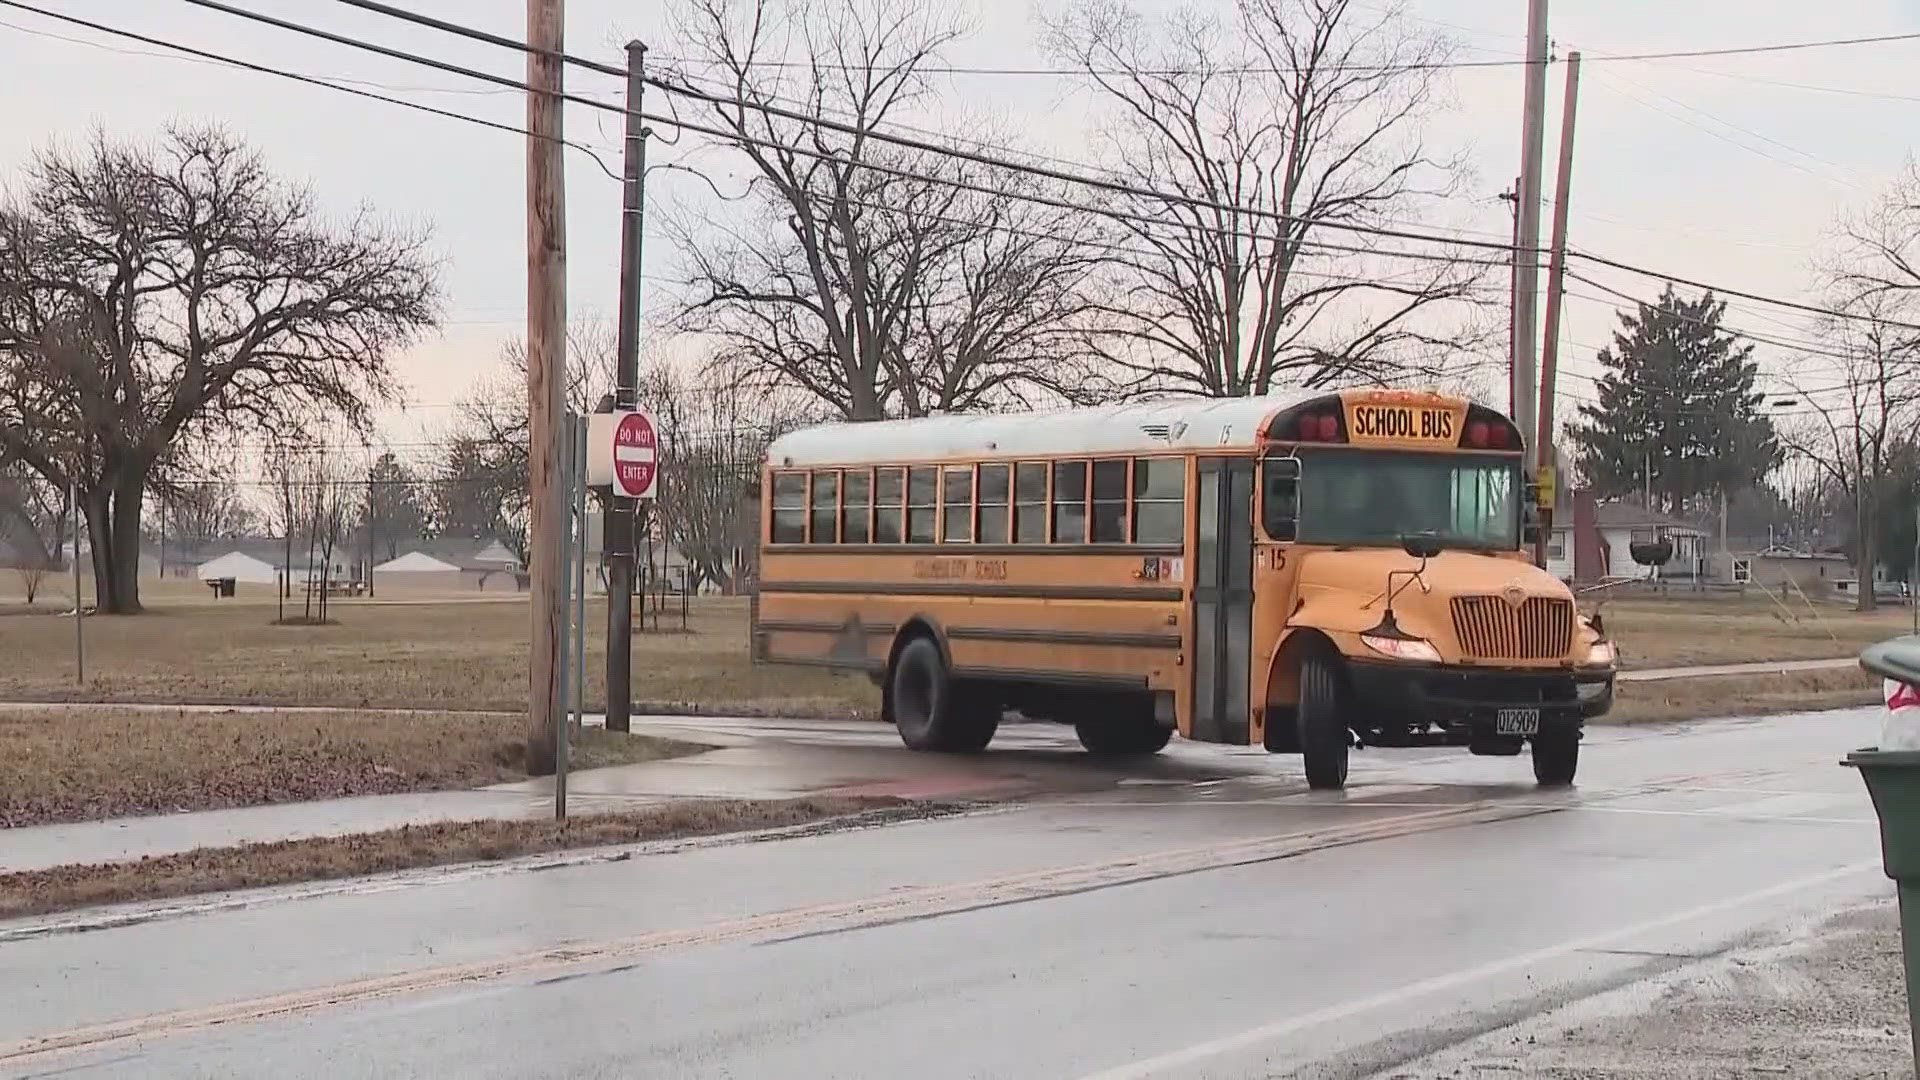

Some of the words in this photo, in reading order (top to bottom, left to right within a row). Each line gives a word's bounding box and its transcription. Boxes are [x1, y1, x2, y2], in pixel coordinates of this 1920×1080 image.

[1355, 406, 1418, 438] SCHOOL
[1421, 411, 1451, 438] BUS
[620, 428, 631, 441] DO
[635, 429, 651, 444] NOT
[623, 465, 648, 480] ENTER
[1271, 549, 1286, 571] 15
